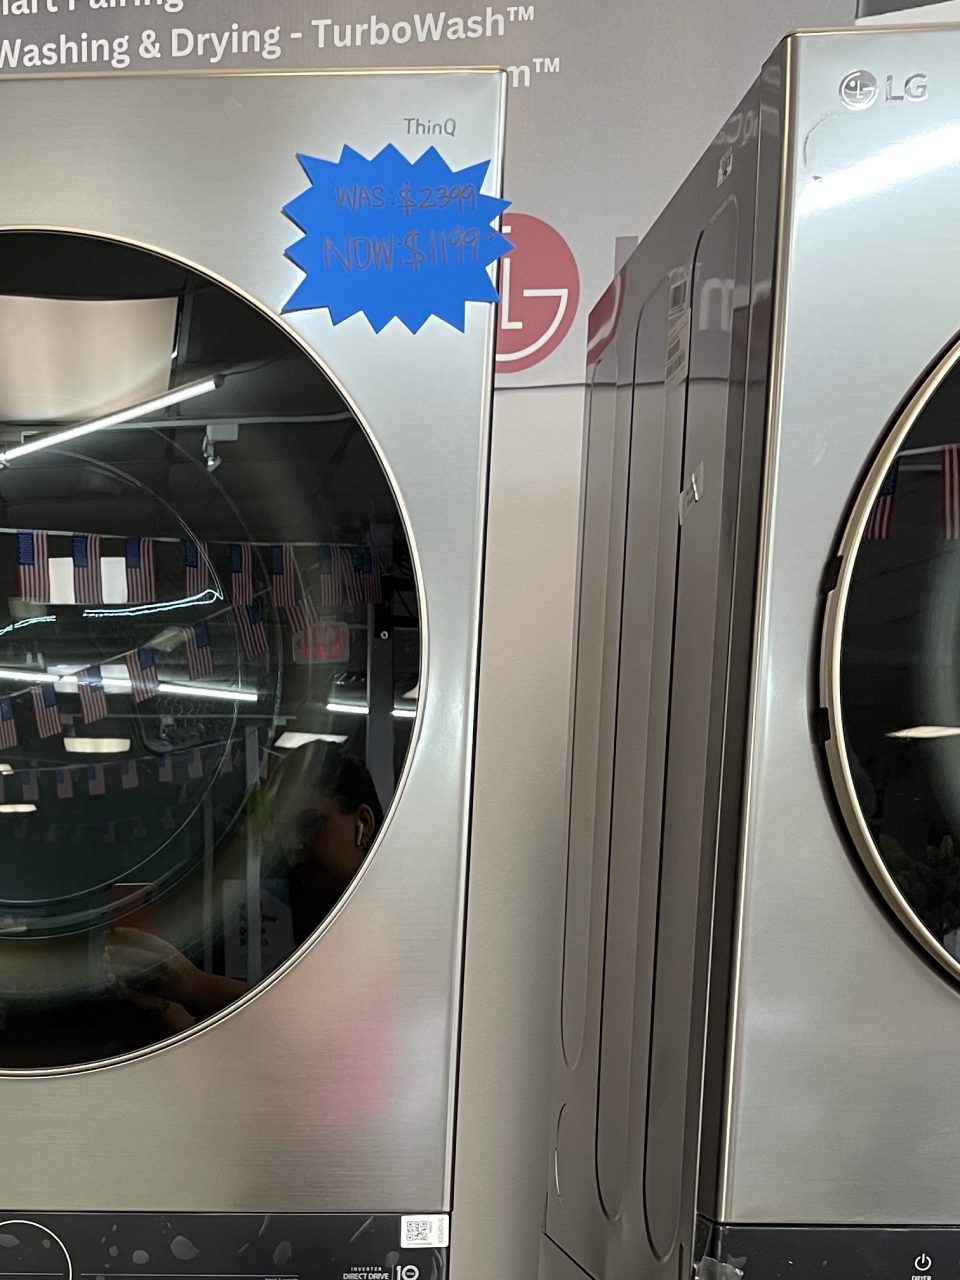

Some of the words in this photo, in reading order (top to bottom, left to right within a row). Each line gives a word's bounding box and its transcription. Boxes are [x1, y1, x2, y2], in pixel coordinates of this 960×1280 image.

[137, 29, 161, 60] &
[171, 22, 283, 63] Drying
[884, 73, 928, 102] LG
[403, 118, 457, 137] ThinQ
[342, 1272, 368, 1280] DIRECT
[368, 1272, 390, 1280] DRIVE
